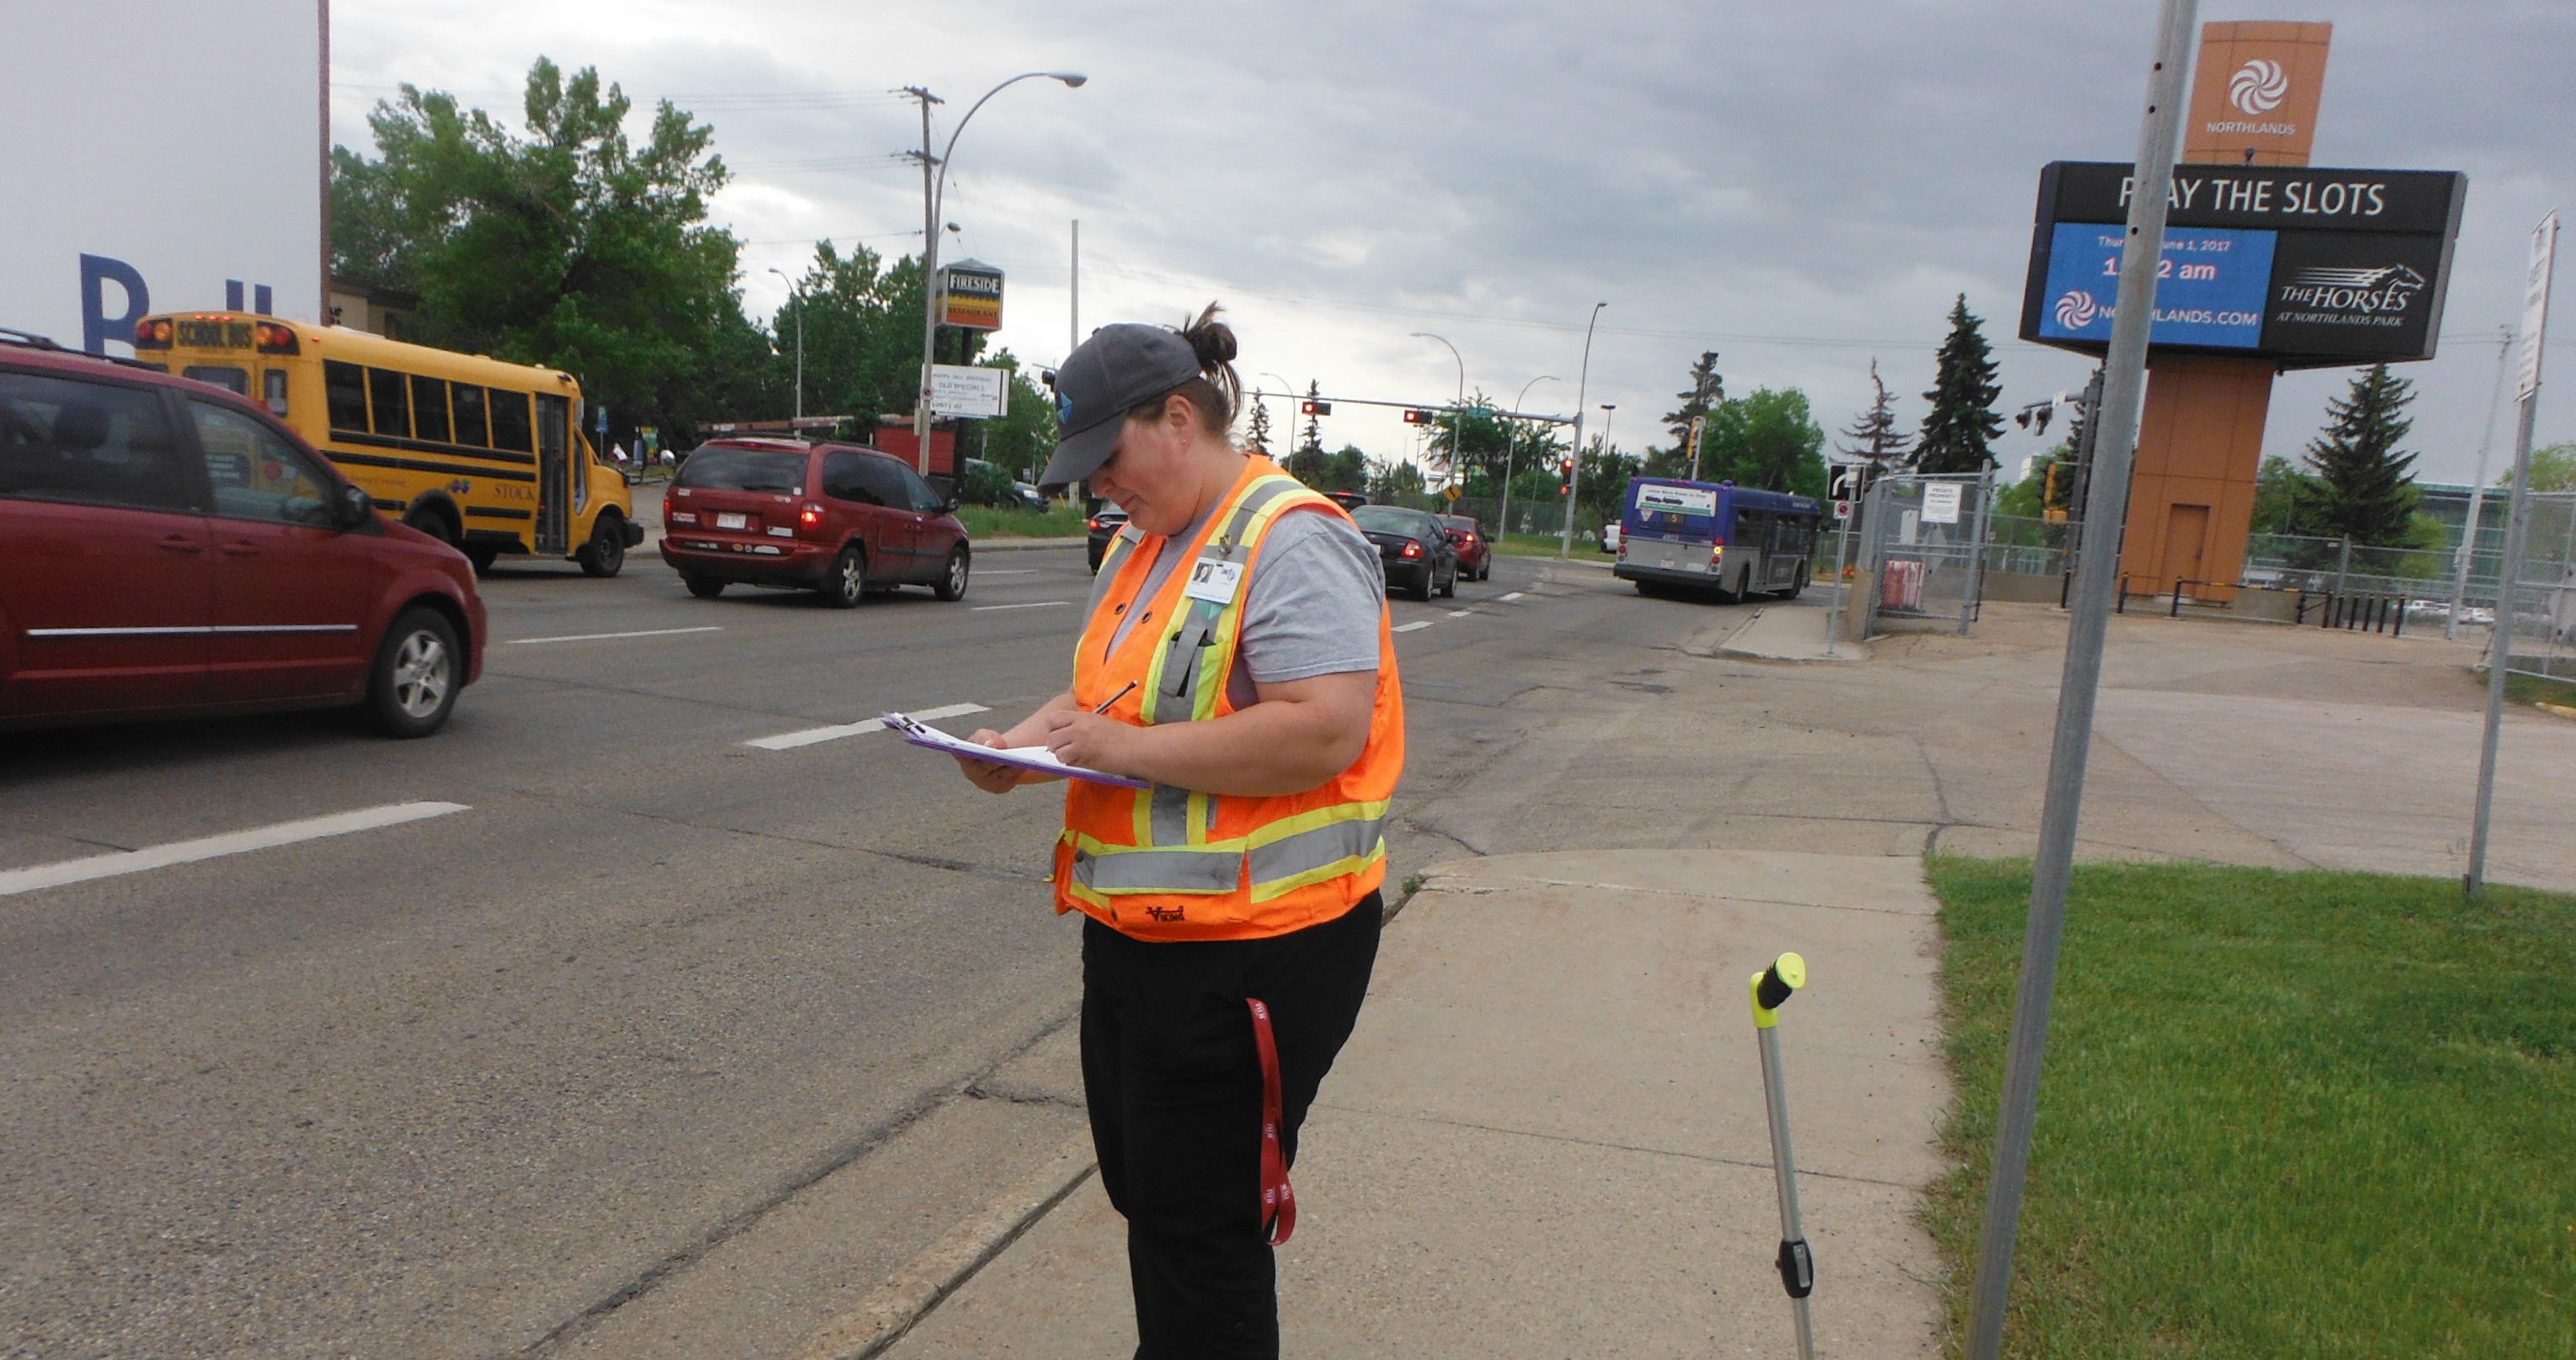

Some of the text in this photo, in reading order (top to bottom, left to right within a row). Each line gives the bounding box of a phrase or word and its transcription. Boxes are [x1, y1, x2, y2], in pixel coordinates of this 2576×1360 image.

[2206, 122, 2297, 135] NORTHLANDS
[2119, 176, 2387, 216] PAY THE SLOTS
[2160, 240, 2185, 251] une
[2200, 241, 2232, 252] 2017
[2179, 262, 2217, 279] am
[949, 274, 1000, 294] FIRESIDE
[2281, 284, 2411, 314] THE HORSES
[2098, 305, 2258, 327] NLANDS.COM
[2276, 311, 2404, 327] AT NORTHLANDS PARK
